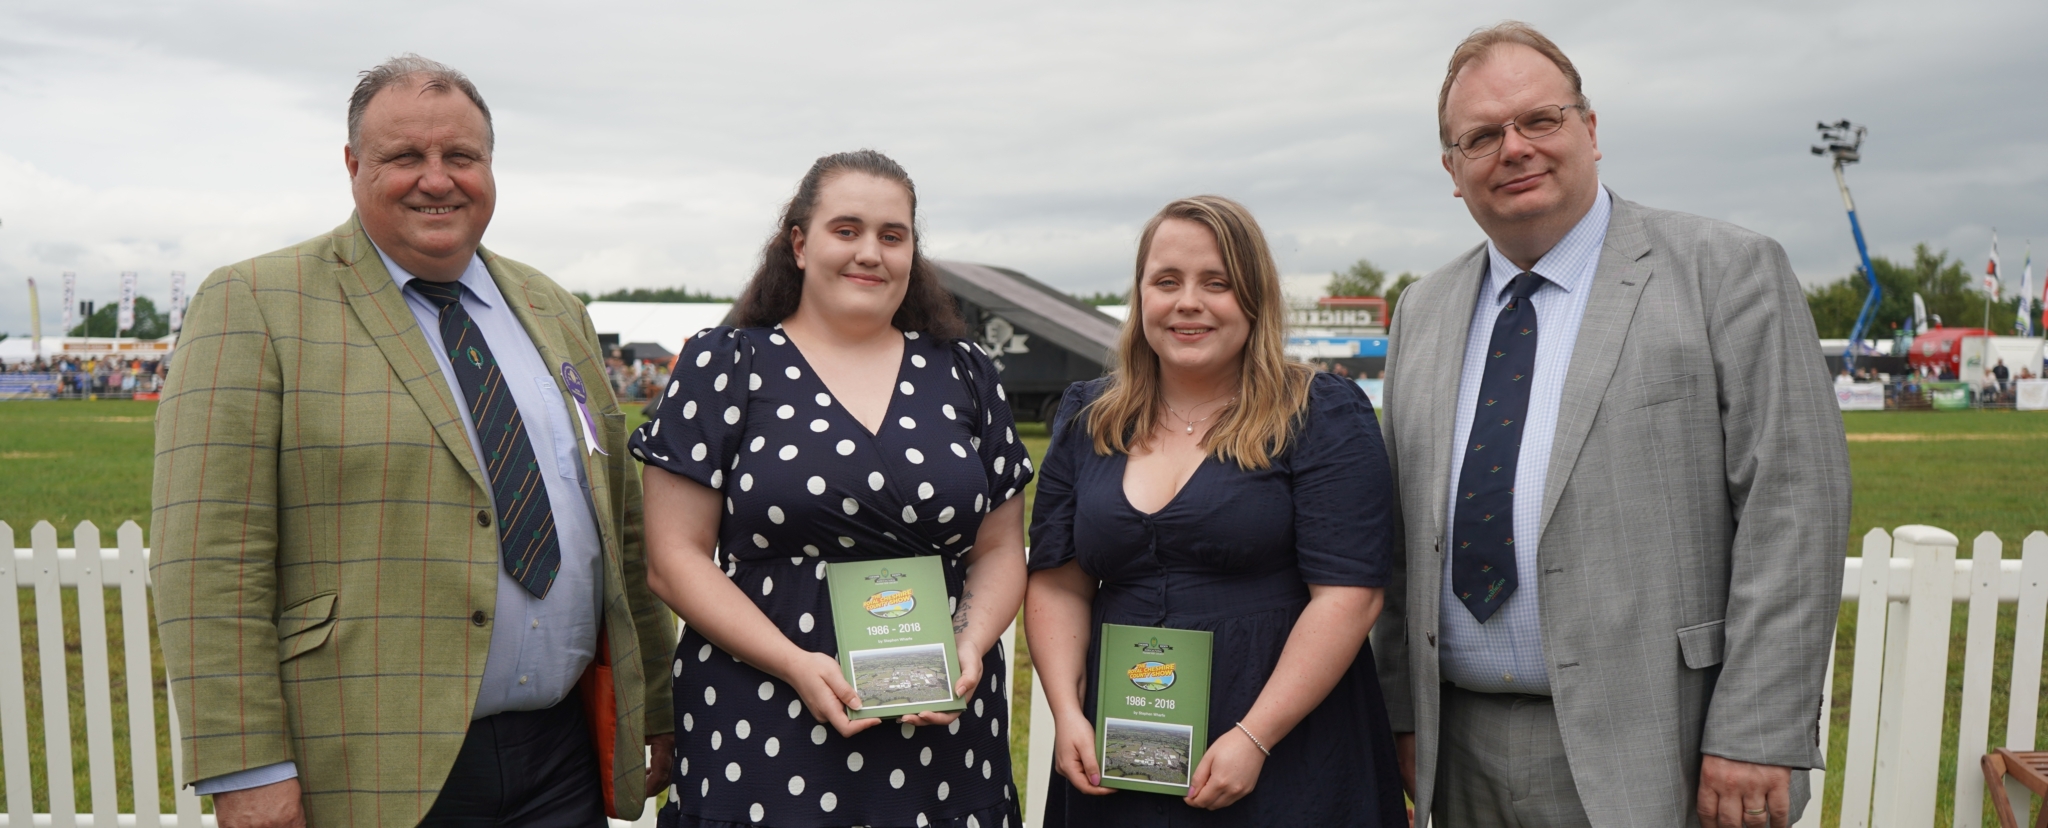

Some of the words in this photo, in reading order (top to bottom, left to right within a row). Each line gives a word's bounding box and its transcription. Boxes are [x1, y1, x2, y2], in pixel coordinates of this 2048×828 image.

[866, 601, 889, 611] COUNTY
[889, 595, 911, 605] SHOW
[866, 625, 889, 636] 1986
[898, 622, 921, 633] 2018
[1143, 663, 1176, 672] CHESHIRE
[1151, 670, 1173, 678] SHOW
[1125, 695, 1146, 707] 1986
[1154, 698, 1175, 710] 2018
